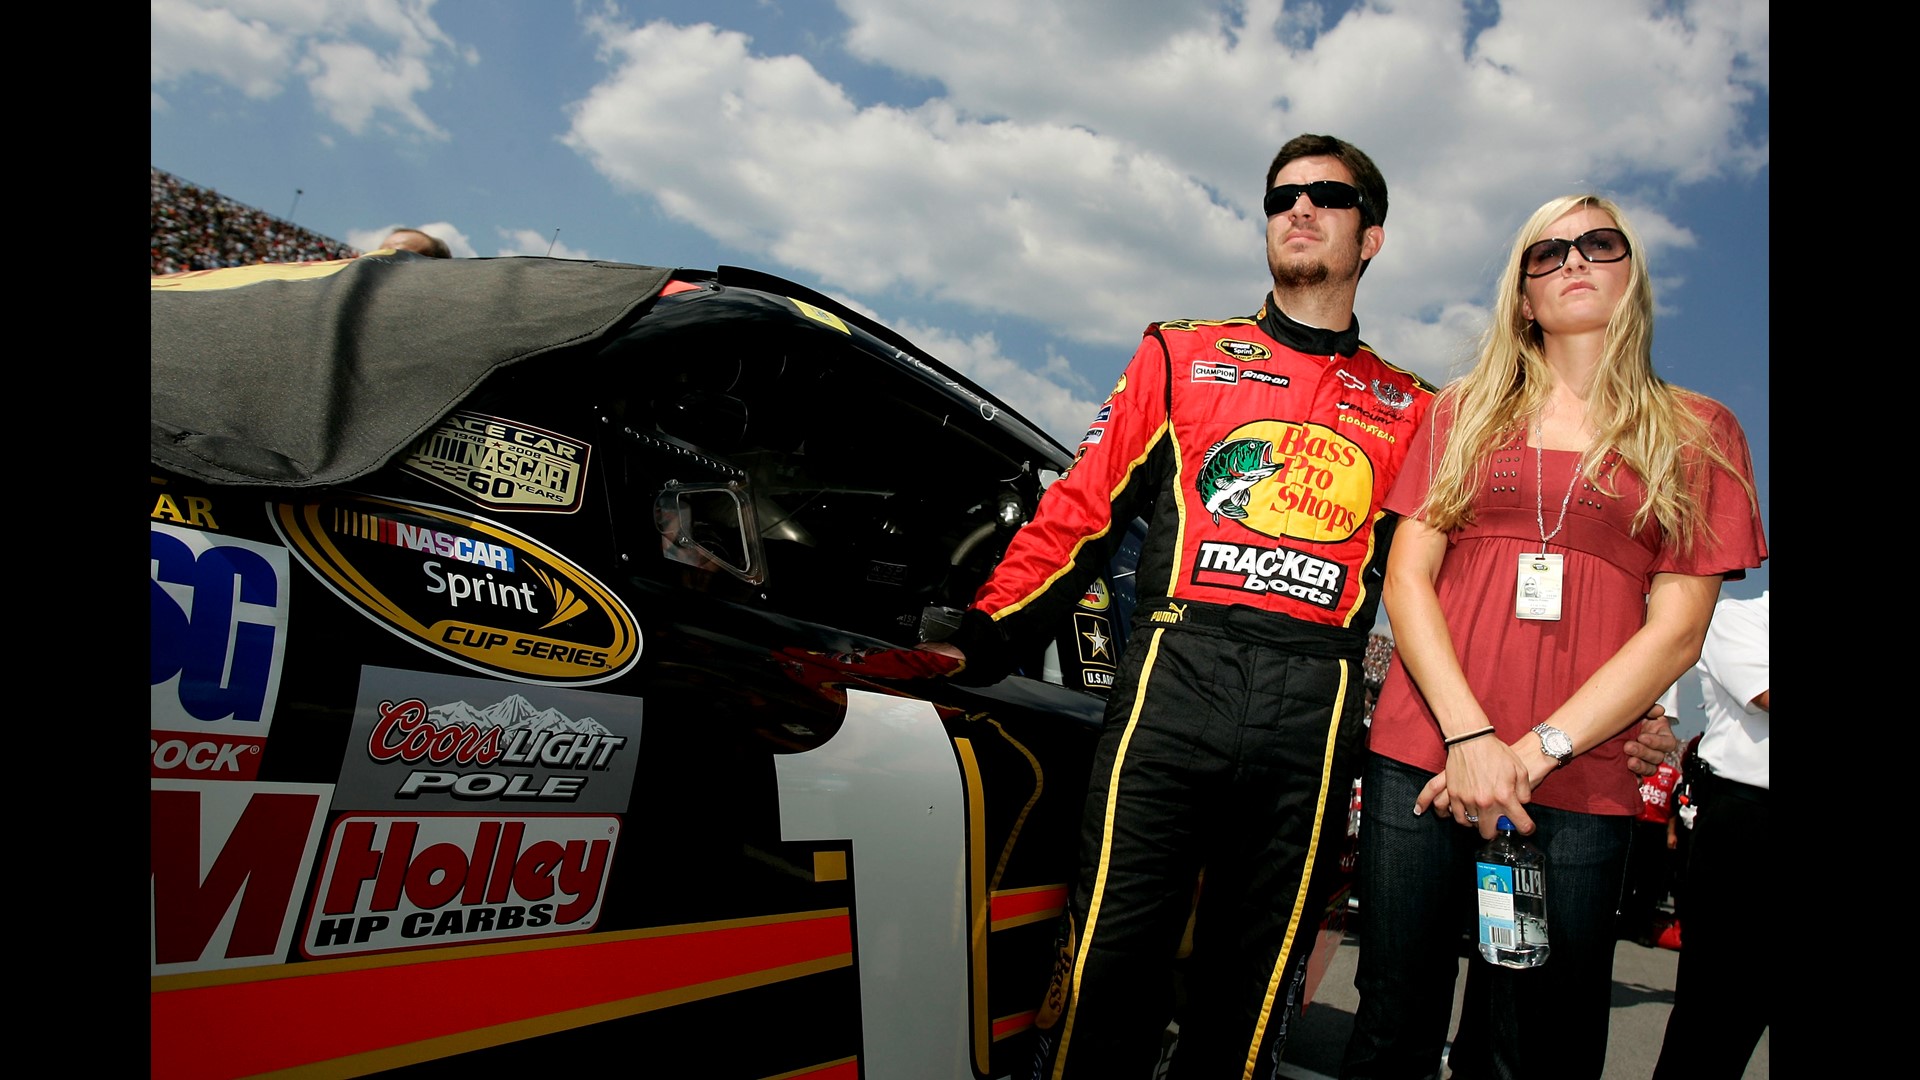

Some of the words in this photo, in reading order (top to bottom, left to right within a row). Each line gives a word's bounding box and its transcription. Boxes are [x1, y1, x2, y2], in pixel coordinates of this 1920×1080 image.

[1233, 347, 1253, 356] Sprint
[1195, 367, 1234, 378] CHAMPION
[1338, 414, 1396, 445] GOODYEAR
[1340, 401, 1393, 425] MERCURY
[453, 432, 486, 444] 1948
[508, 445, 541, 459] 2008
[514, 431, 577, 460] CAR
[1276, 426, 1358, 467] Bass
[463, 443, 565, 492] NASCAR
[1274, 455, 1334, 490] Pro
[467, 471, 515, 499] 60
[517, 483, 564, 503] YEARS
[1270, 482, 1356, 533] Shops
[397, 522, 509, 572] NASCAR
[1199, 542, 1341, 591] TRACKER
[423, 560, 539, 613] Sprint
[1244, 573, 1333, 605] boats
[1150, 611, 1179, 623] PUMA
[441, 625, 509, 650] CUP
[511, 638, 608, 668] SERIES
[367, 698, 502, 767] Coors
[500, 729, 628, 771] LIGHT
[151, 738, 250, 772] OCK
[395, 769, 589, 803] POLE
[322, 821, 611, 925] Holley
[774, 688, 973, 1080] 1
[314, 915, 389, 947] HP
[401, 903, 553, 939] CARBS
